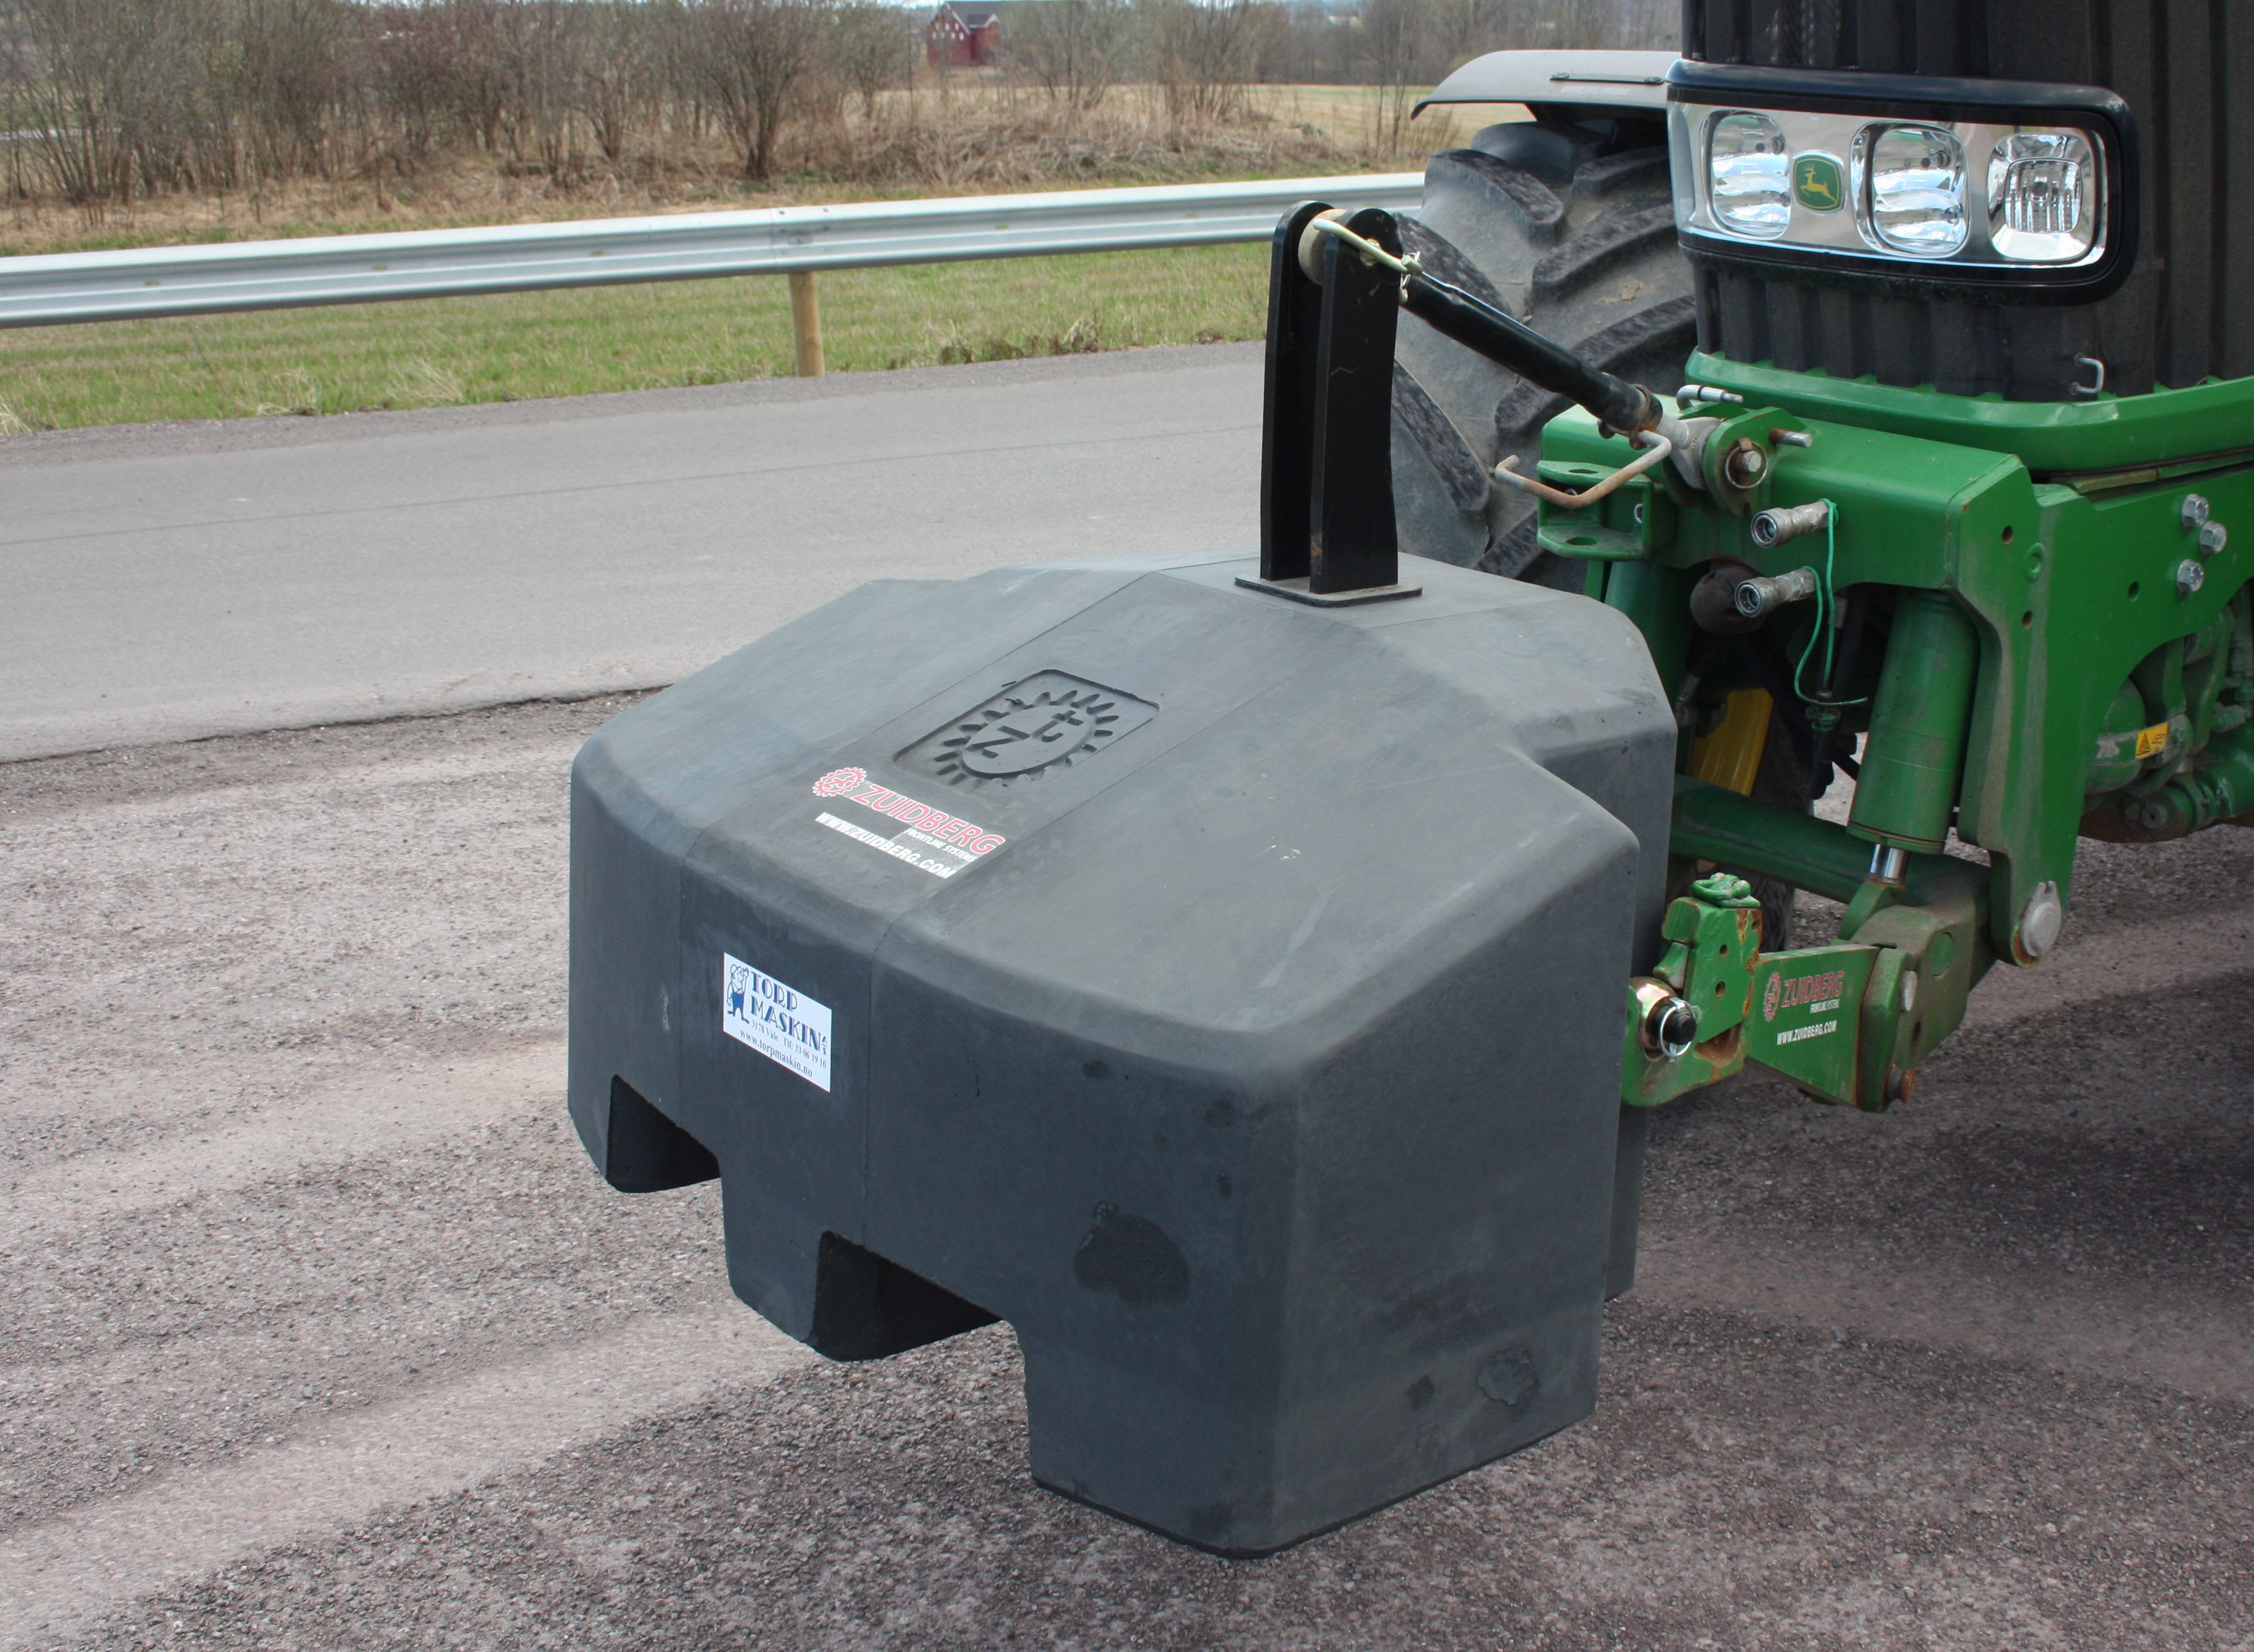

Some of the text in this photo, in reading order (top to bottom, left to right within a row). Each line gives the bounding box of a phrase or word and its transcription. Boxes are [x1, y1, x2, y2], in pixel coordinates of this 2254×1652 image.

[850, 784, 1005, 854] ZUIDBERG
[815, 812, 956, 879] WWW.ZUIDBERG.COM
[903, 829, 978, 862] FRONTLINE SYSTEMS
[751, 971, 797, 1012] TORP
[1781, 970, 1844, 1008] ZUIDBERG
[751, 995, 821, 1052] MASKIN
[751, 1020, 765, 1034] 3178
[803, 1048, 810, 1060] 06
[811, 1053, 819, 1064] 19
[820, 1057, 827, 1068] 10
[1777, 1020, 1837, 1045] WWW.ZUIDBERG.COM
[740, 1029, 813, 1077] www.torpmaskin.no
